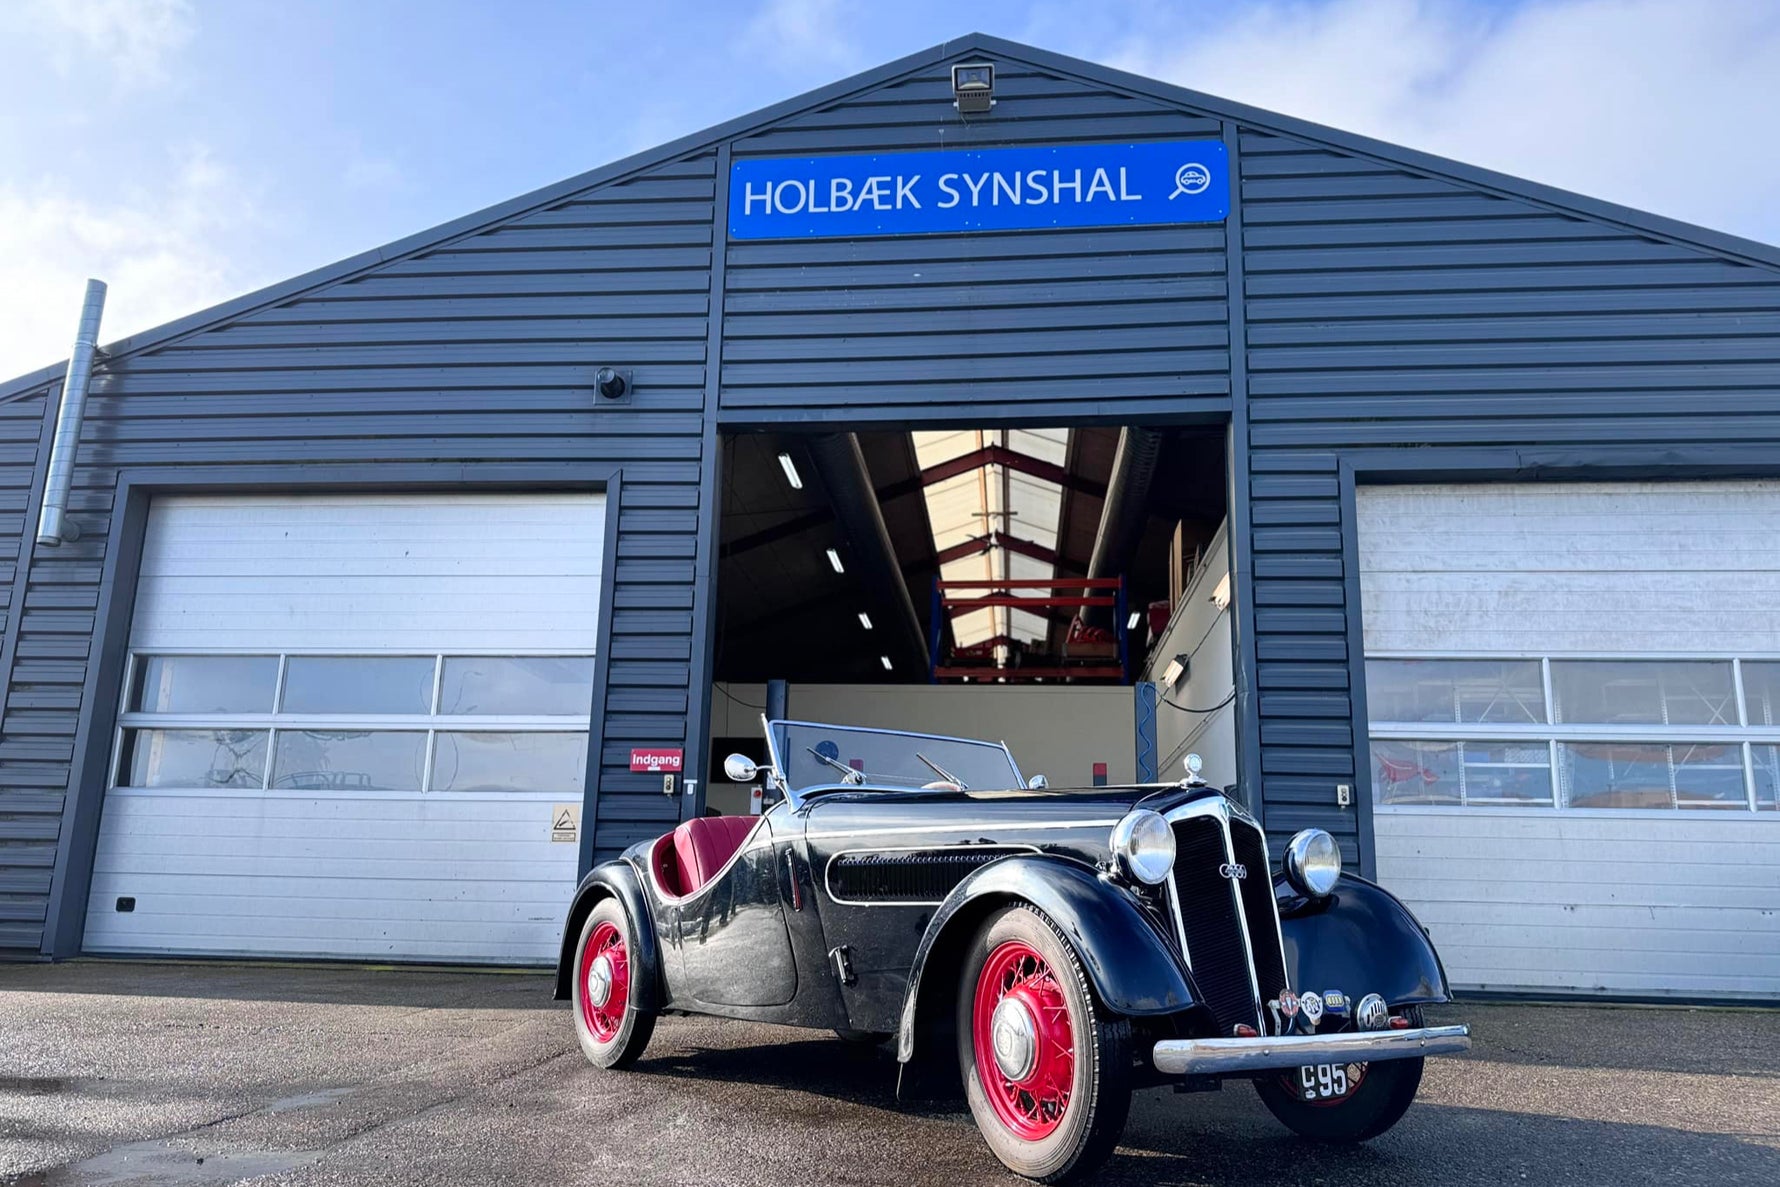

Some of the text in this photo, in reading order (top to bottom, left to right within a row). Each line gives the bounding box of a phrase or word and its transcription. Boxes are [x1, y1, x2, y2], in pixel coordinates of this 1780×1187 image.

[744, 166, 1142, 215] HOLBÆK SYNSHAL
[632, 753, 681, 767] Indgang
